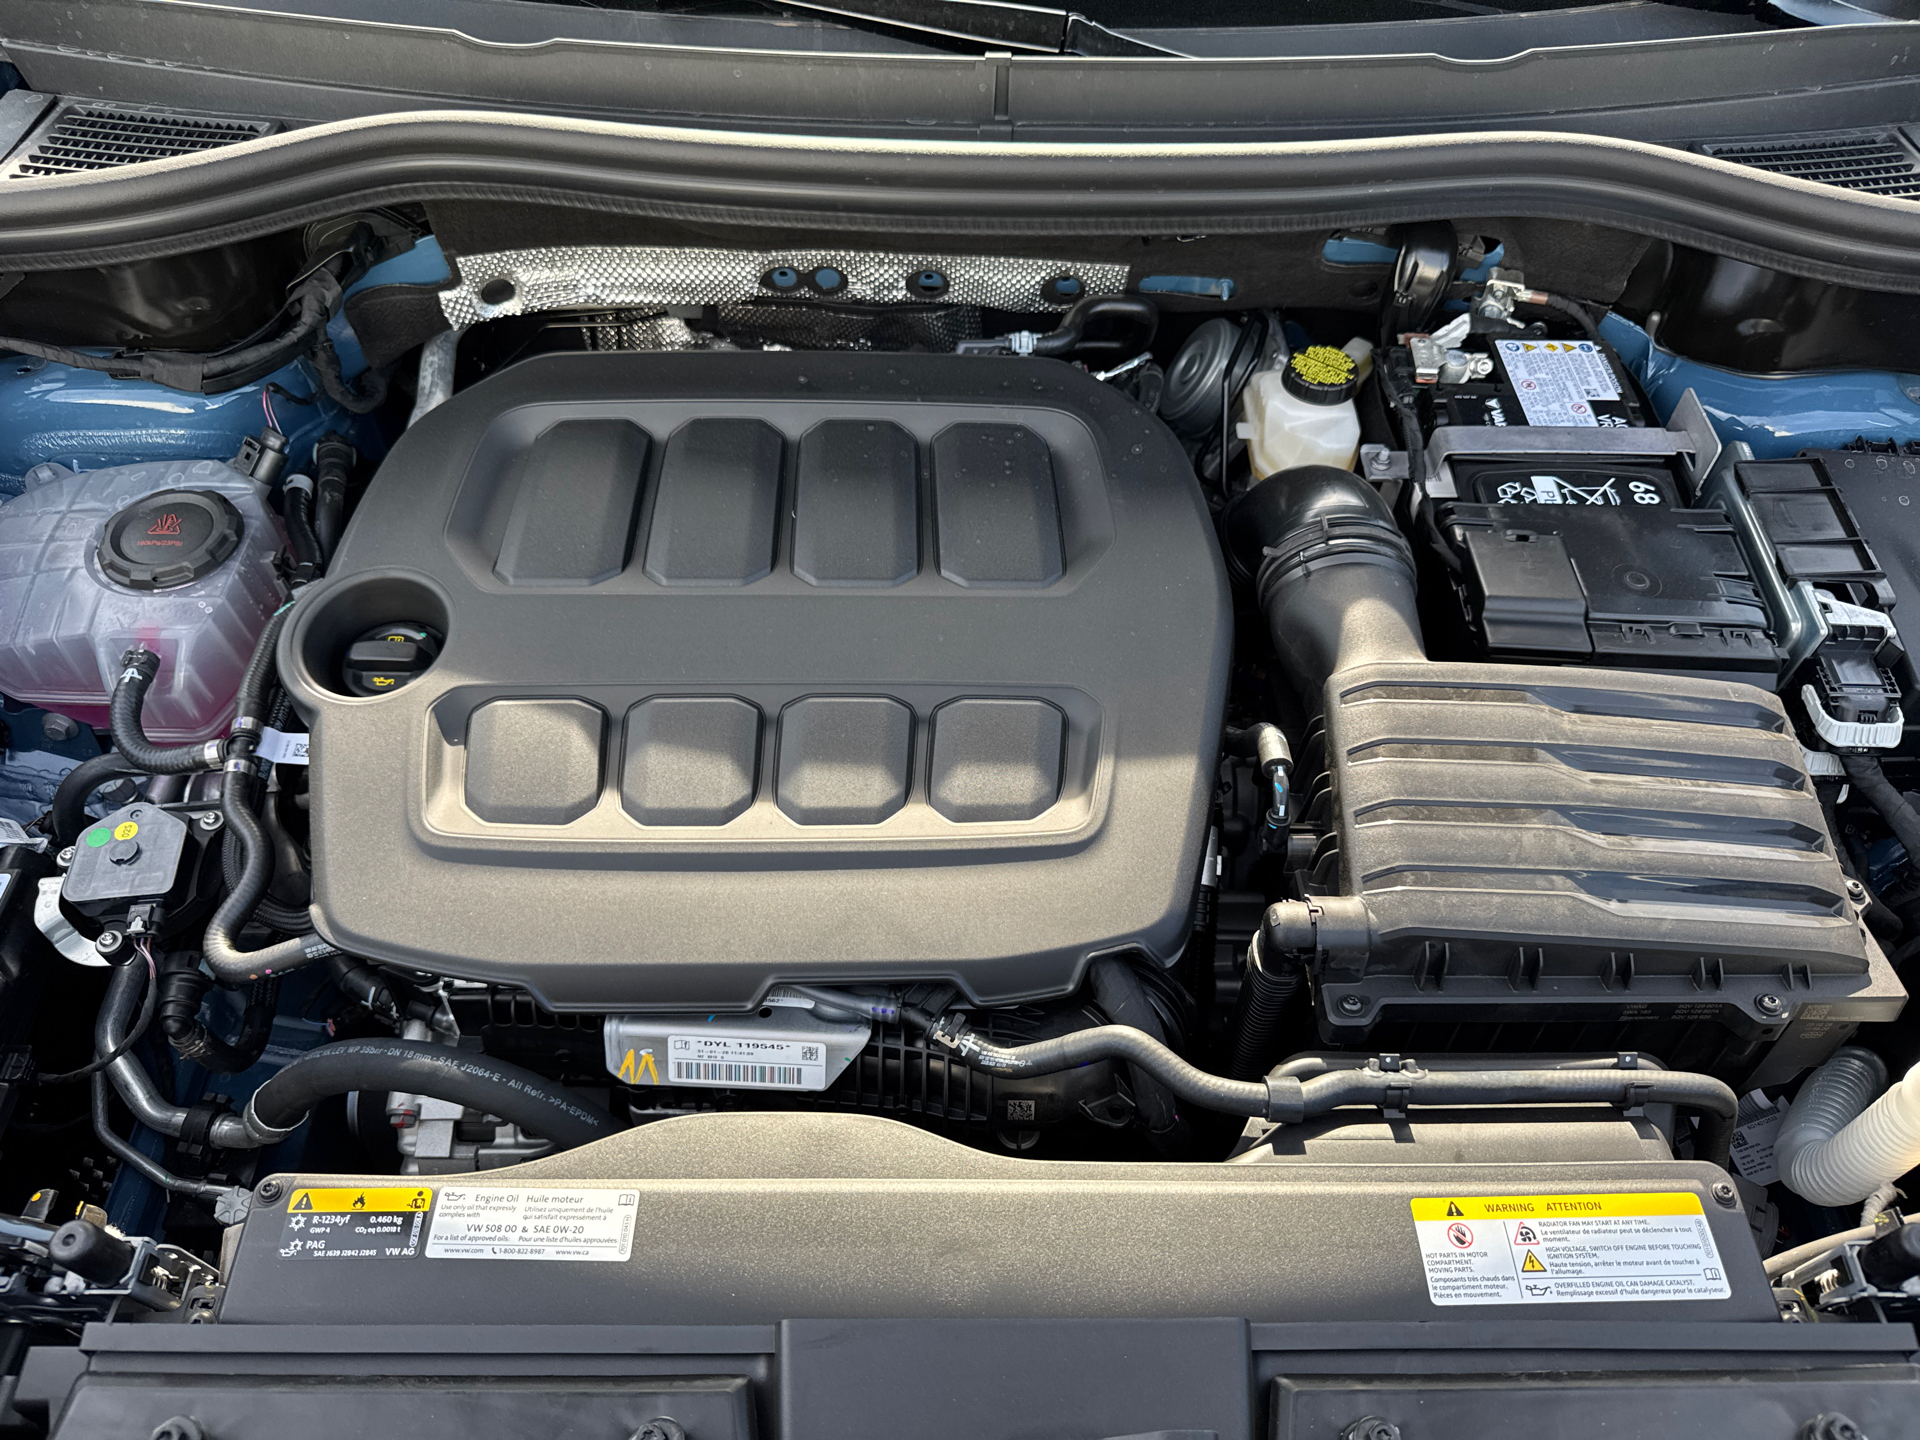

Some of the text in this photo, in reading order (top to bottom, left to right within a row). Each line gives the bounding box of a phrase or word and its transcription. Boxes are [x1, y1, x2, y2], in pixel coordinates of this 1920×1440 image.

[387, 1047, 402, 1057] DN
[460, 1063, 501, 1082] J2064-E
[507, 1078, 523, 1090] All
[549, 1096, 600, 1127] >PA-EPDM<
[475, 1194, 505, 1204] Engine
[506, 1194, 520, 1202] Oil
[526, 1195, 549, 1203] Huile
[489, 1205, 517, 1213] expressly
[548, 1207, 586, 1215] uniquement
[1484, 1201, 1602, 1213] WARNING ATTENTION
[312, 1215, 351, 1226] R-1234yf
[393, 1216, 403, 1225] kg
[558, 1214, 602, 1222] expressément
[466, 1224, 484, 1232] VW
[484, 1224, 503, 1233] 508
[504, 1224, 518, 1233] 00
[533, 1225, 552, 1233] SAE
[552, 1225, 585, 1234] 0W-20
[467, 1234, 497, 1242] approved
[305, 1240, 326, 1249] PAG
[385, 1248, 401, 1256] VW
[401, 1248, 415, 1256] AG
[1430, 1275, 1467, 1284] Composants
[1640, 1288, 1672, 1296] dangereux
